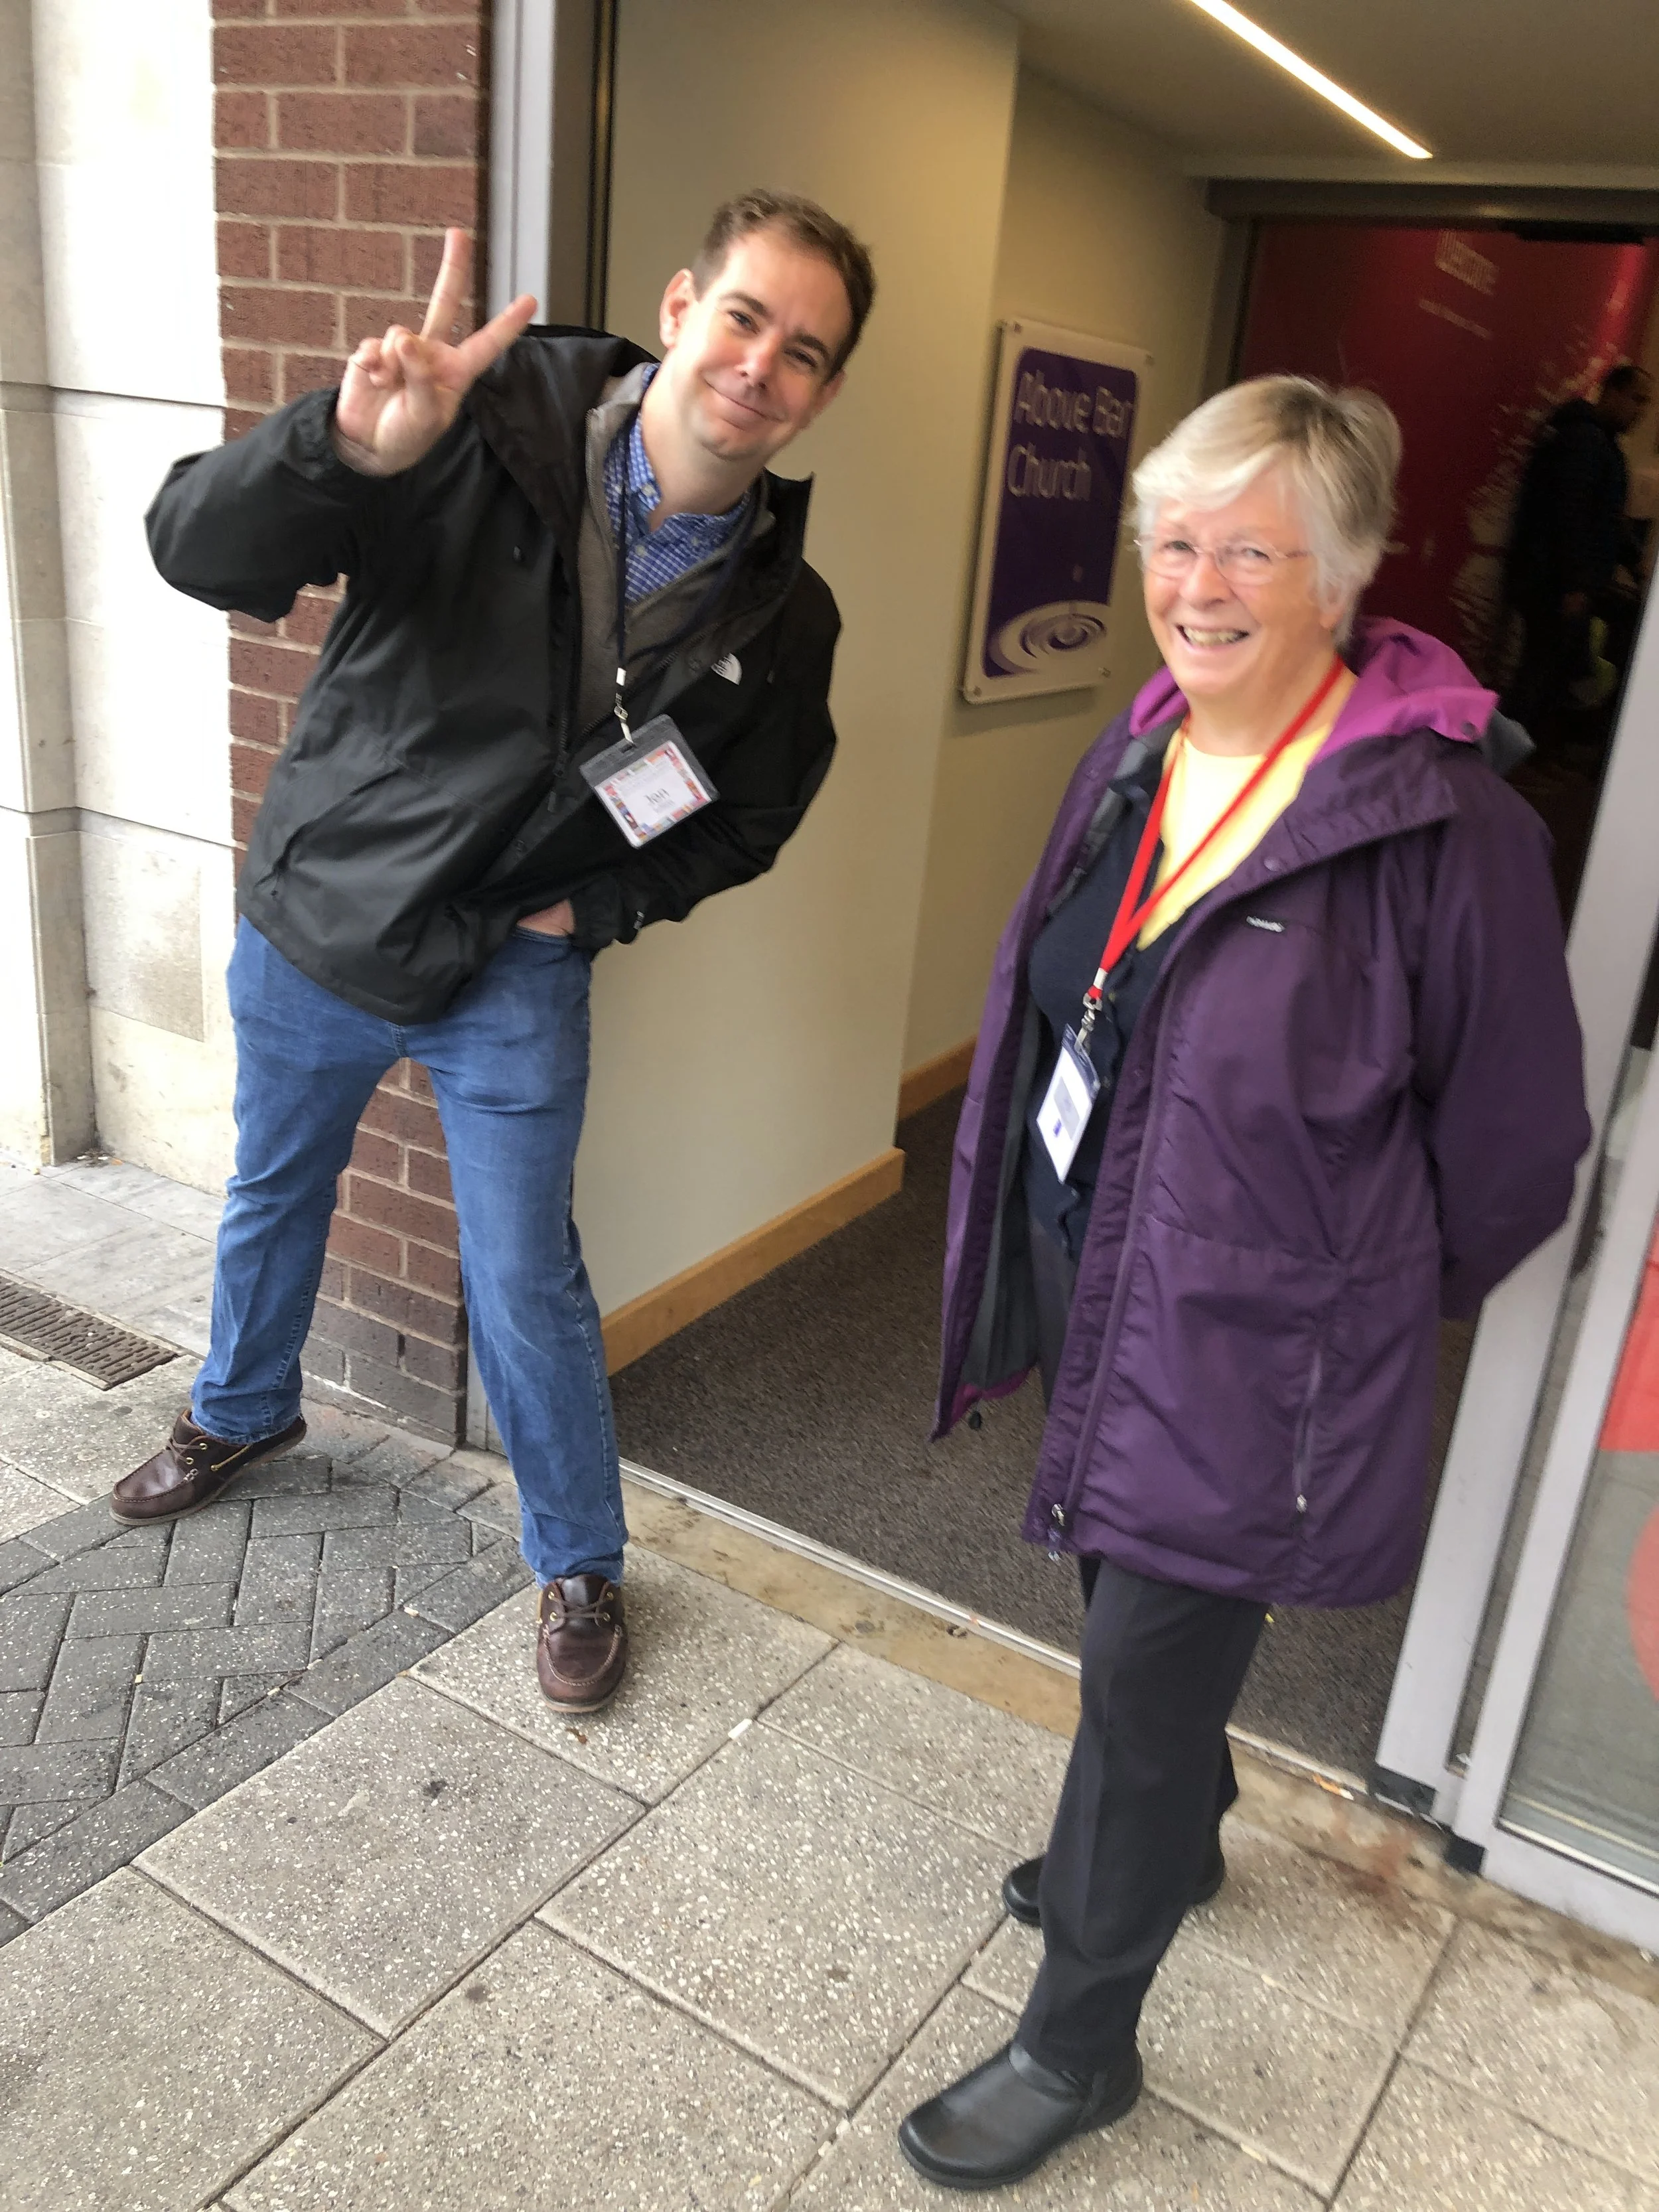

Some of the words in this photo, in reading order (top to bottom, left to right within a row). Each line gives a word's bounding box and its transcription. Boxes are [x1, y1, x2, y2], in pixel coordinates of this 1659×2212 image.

[1013, 370, 1091, 433] Above
[1092, 386, 1132, 439] Bar
[1007, 443, 1092, 501] Church
